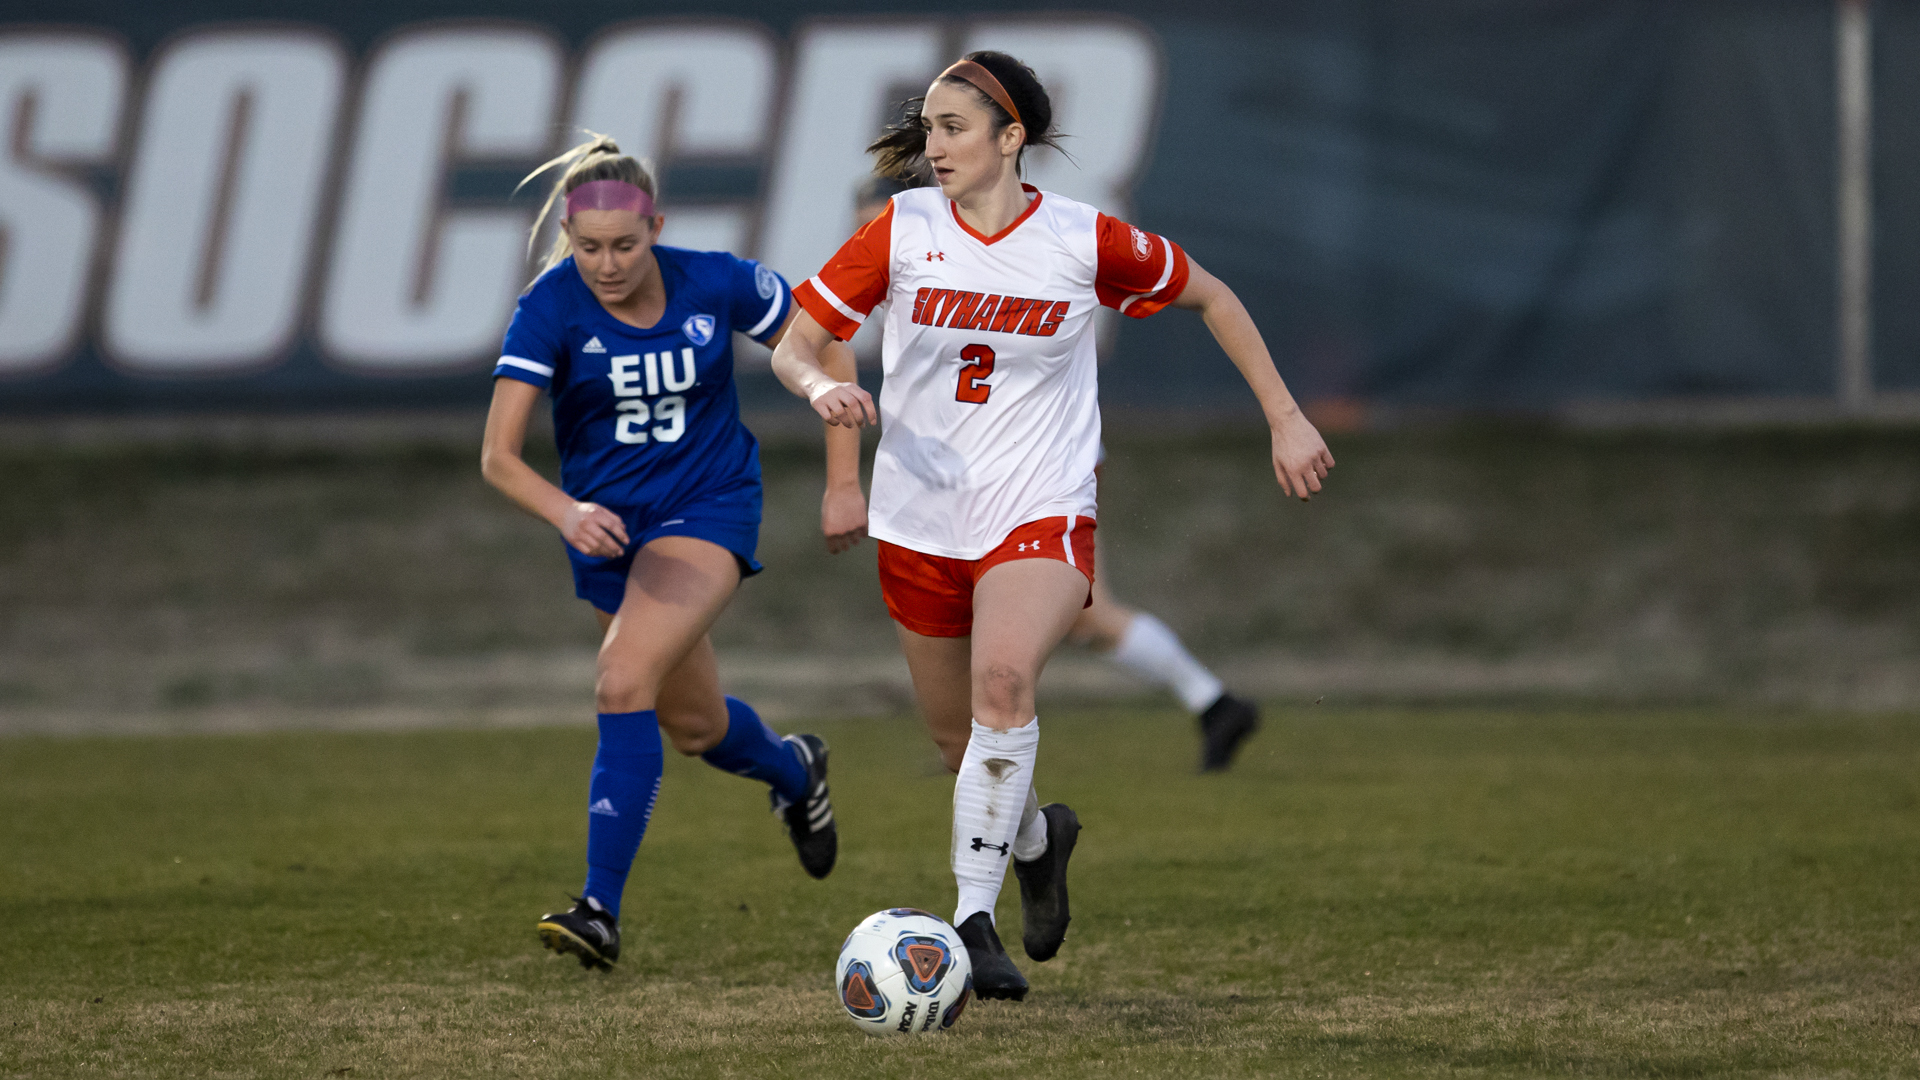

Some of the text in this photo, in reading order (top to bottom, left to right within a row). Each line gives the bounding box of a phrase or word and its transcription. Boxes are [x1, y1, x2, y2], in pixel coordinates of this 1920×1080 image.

[911, 286, 1071, 337] SKYHAWKS
[607, 347, 697, 397] EIU
[955, 343, 996, 404] 2
[615, 396, 686, 444] 29
